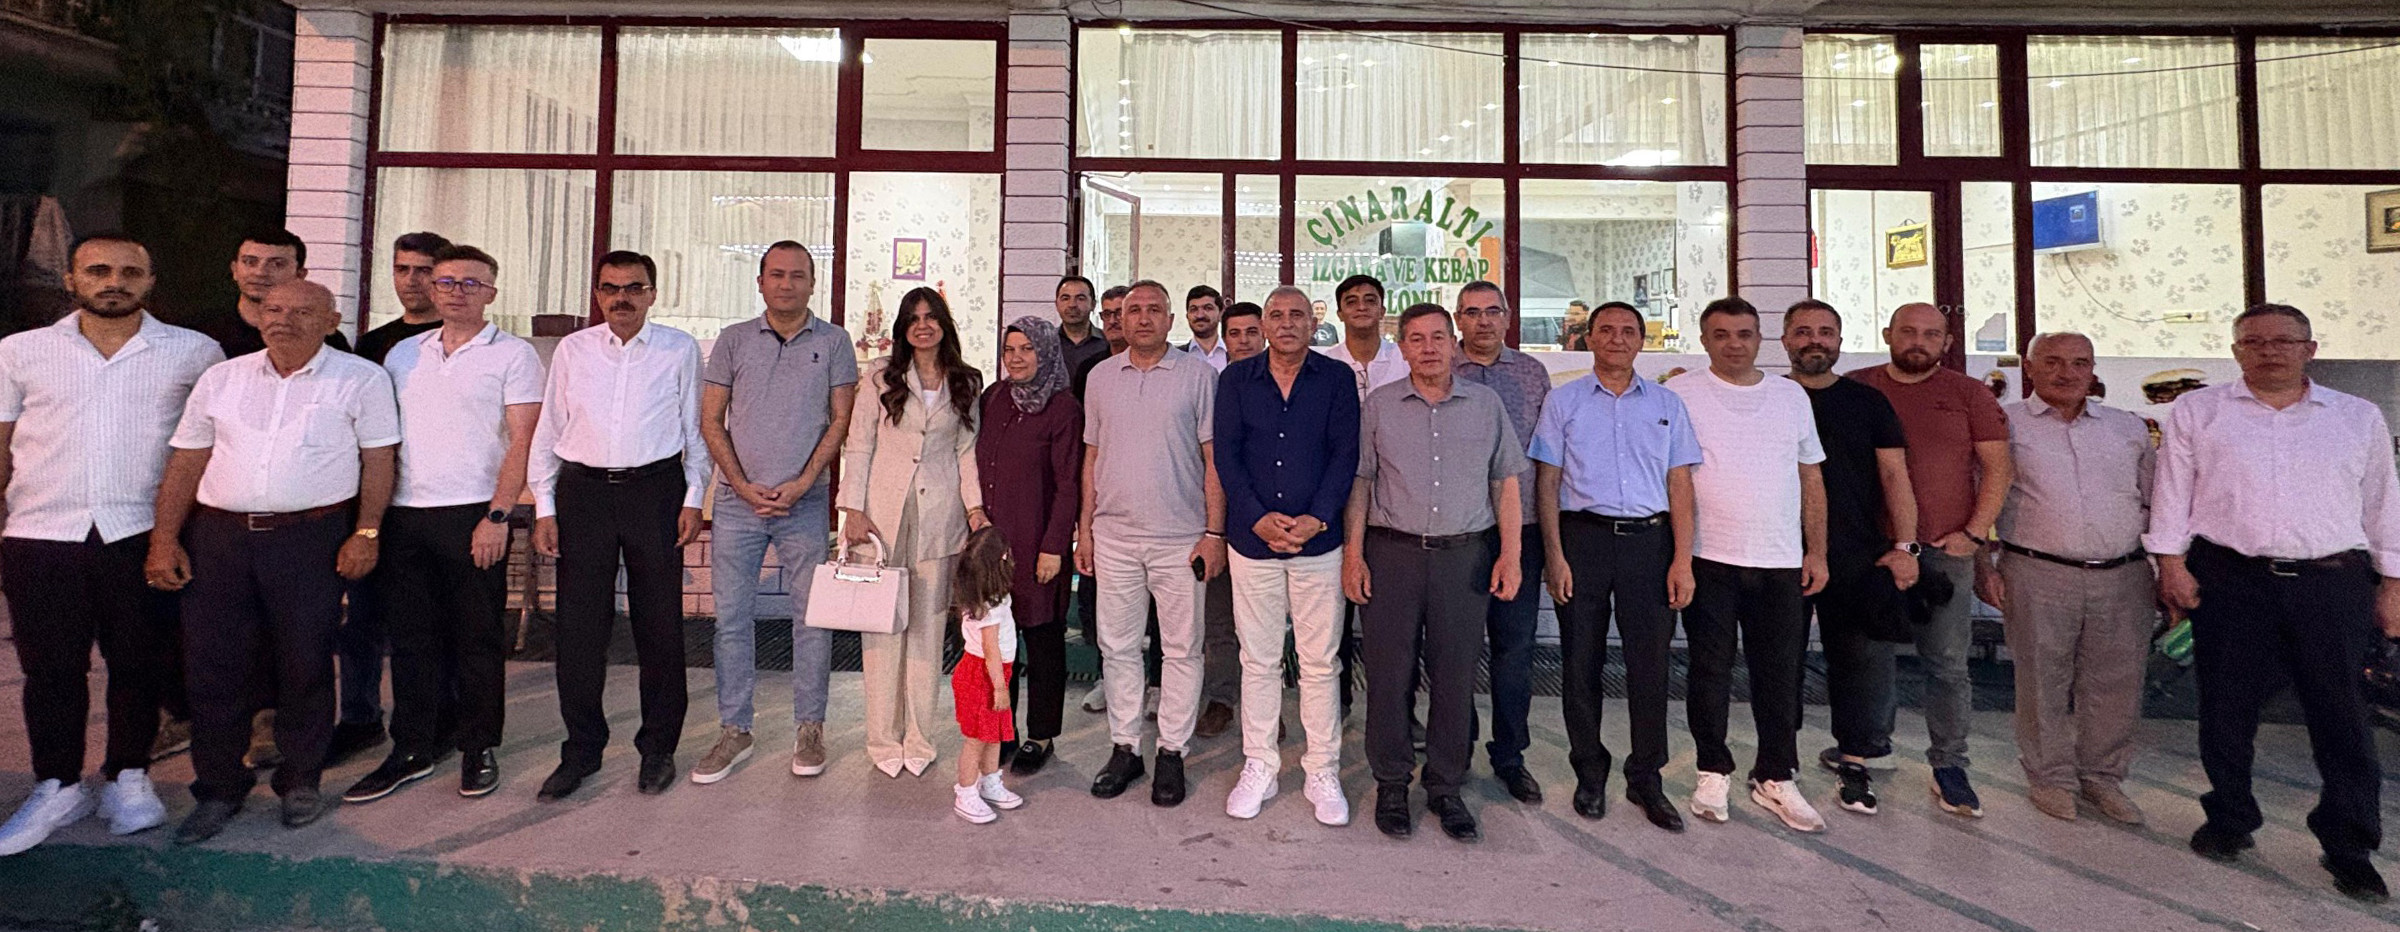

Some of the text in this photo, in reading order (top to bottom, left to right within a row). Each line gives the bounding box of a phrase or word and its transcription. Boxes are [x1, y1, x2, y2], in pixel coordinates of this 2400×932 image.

[1307, 186, 1493, 249] ÇINARALTI
[1391, 257, 1417, 282] VE
[1424, 257, 1489, 283] KEBAP
[1386, 289, 1441, 314] LONU
